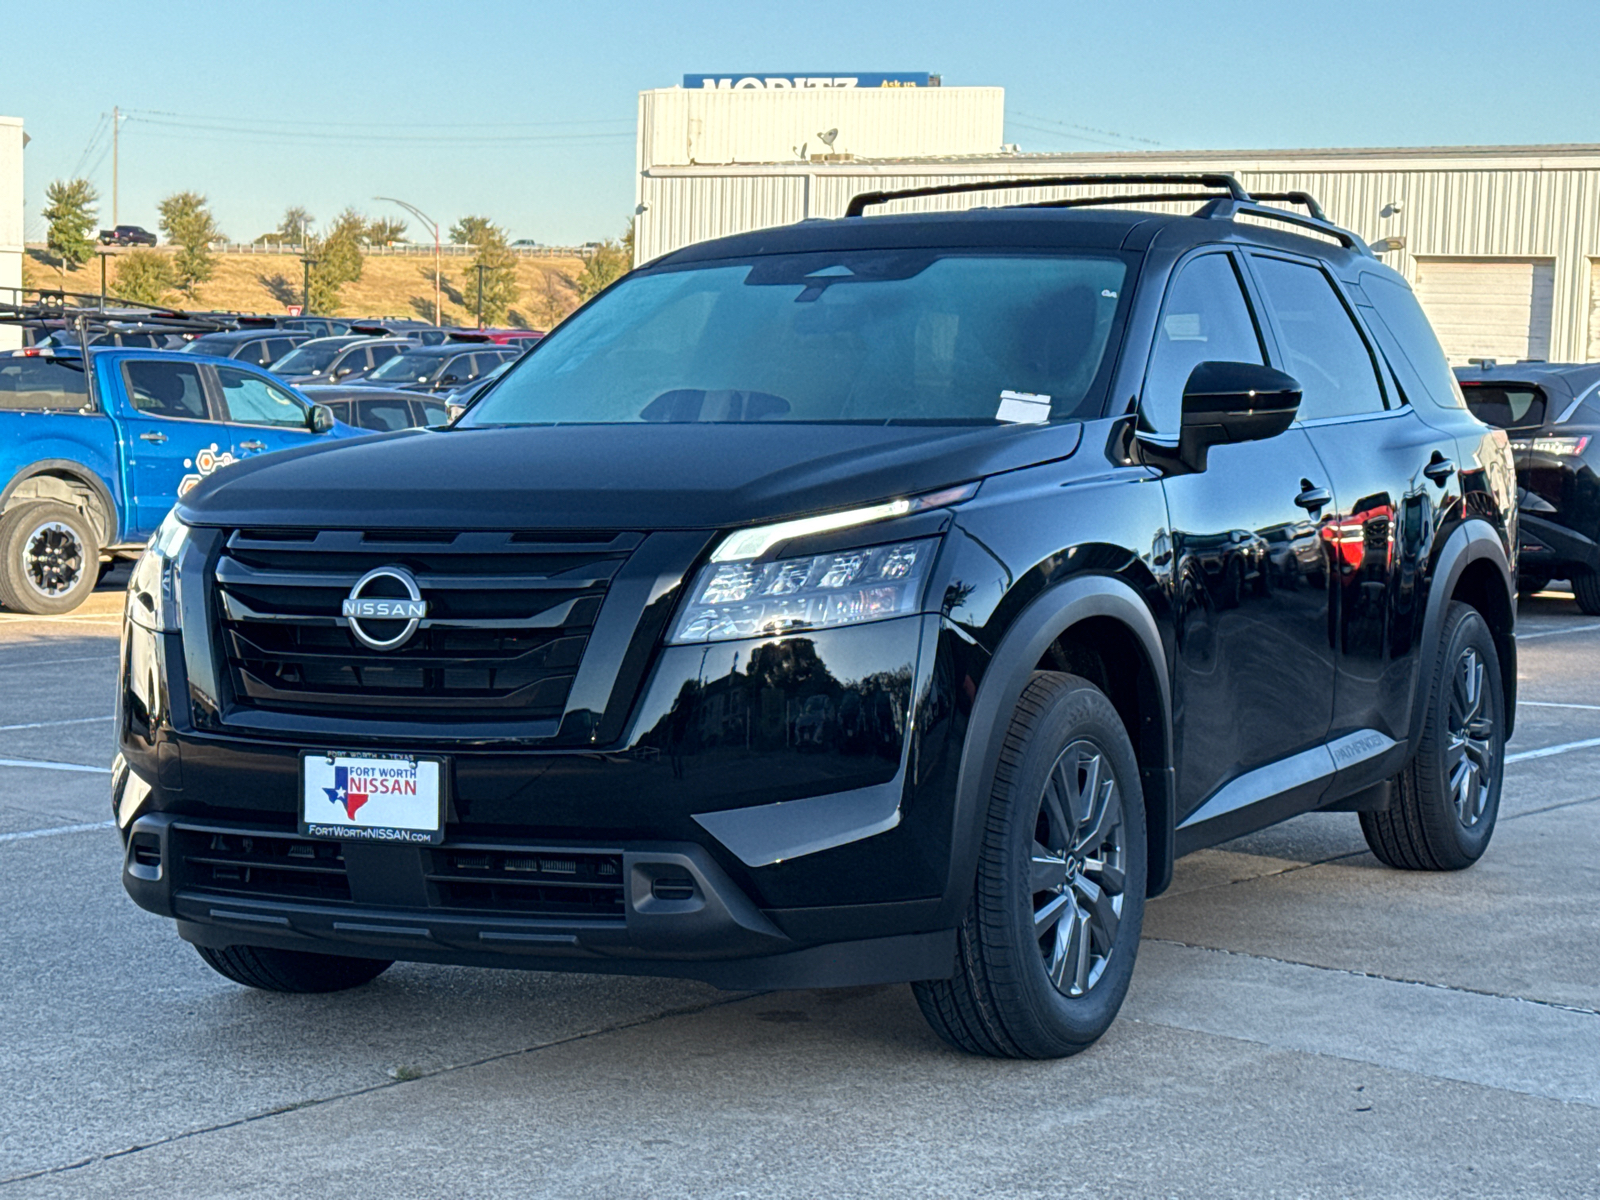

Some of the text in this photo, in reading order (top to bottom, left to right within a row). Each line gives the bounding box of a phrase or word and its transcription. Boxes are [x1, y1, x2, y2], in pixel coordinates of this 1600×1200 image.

[344, 603, 423, 616] NISSAN
[349, 767, 417, 779] FORT WORTH
[349, 777, 417, 796] NISSAN
